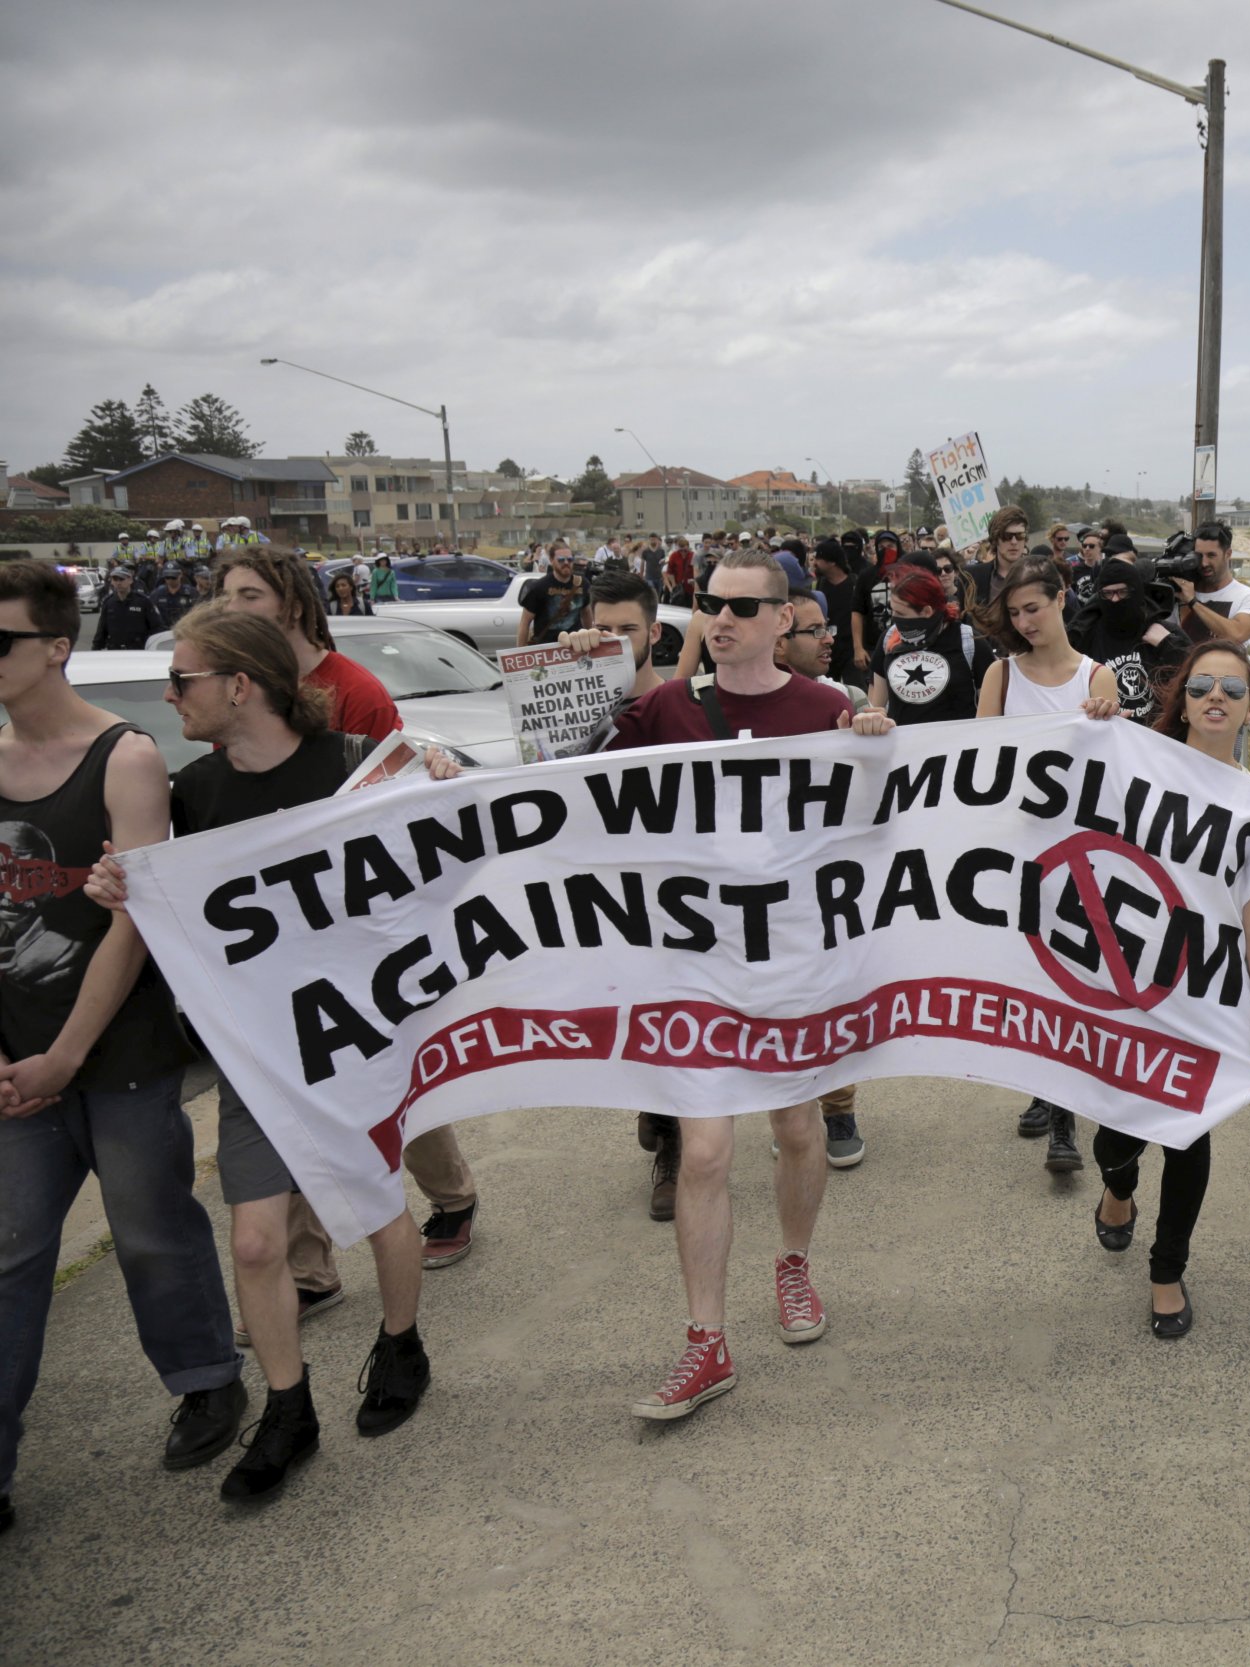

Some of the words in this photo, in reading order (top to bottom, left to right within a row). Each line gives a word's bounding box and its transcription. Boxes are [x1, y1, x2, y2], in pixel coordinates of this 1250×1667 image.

[929, 436, 976, 475] Fight
[937, 463, 987, 498] Racism
[948, 483, 985, 515] NOT
[504, 648, 572, 672] REDFLAG
[521, 697, 574, 717] MEDIA
[576, 687, 623, 708] FUELS
[533, 679, 572, 699] HOW
[575, 675, 606, 692] THE
[521, 702, 619, 733] ANTI-MUSLI
[203, 789, 568, 965] STAND
[584, 759, 854, 835] WITH
[291, 872, 789, 1086] AGAINST
[405, 1017, 593, 1105] DFLAG
[638, 1004, 878, 1063] SOCIALIST
[890, 987, 1198, 1098] ALTERNATIVE
